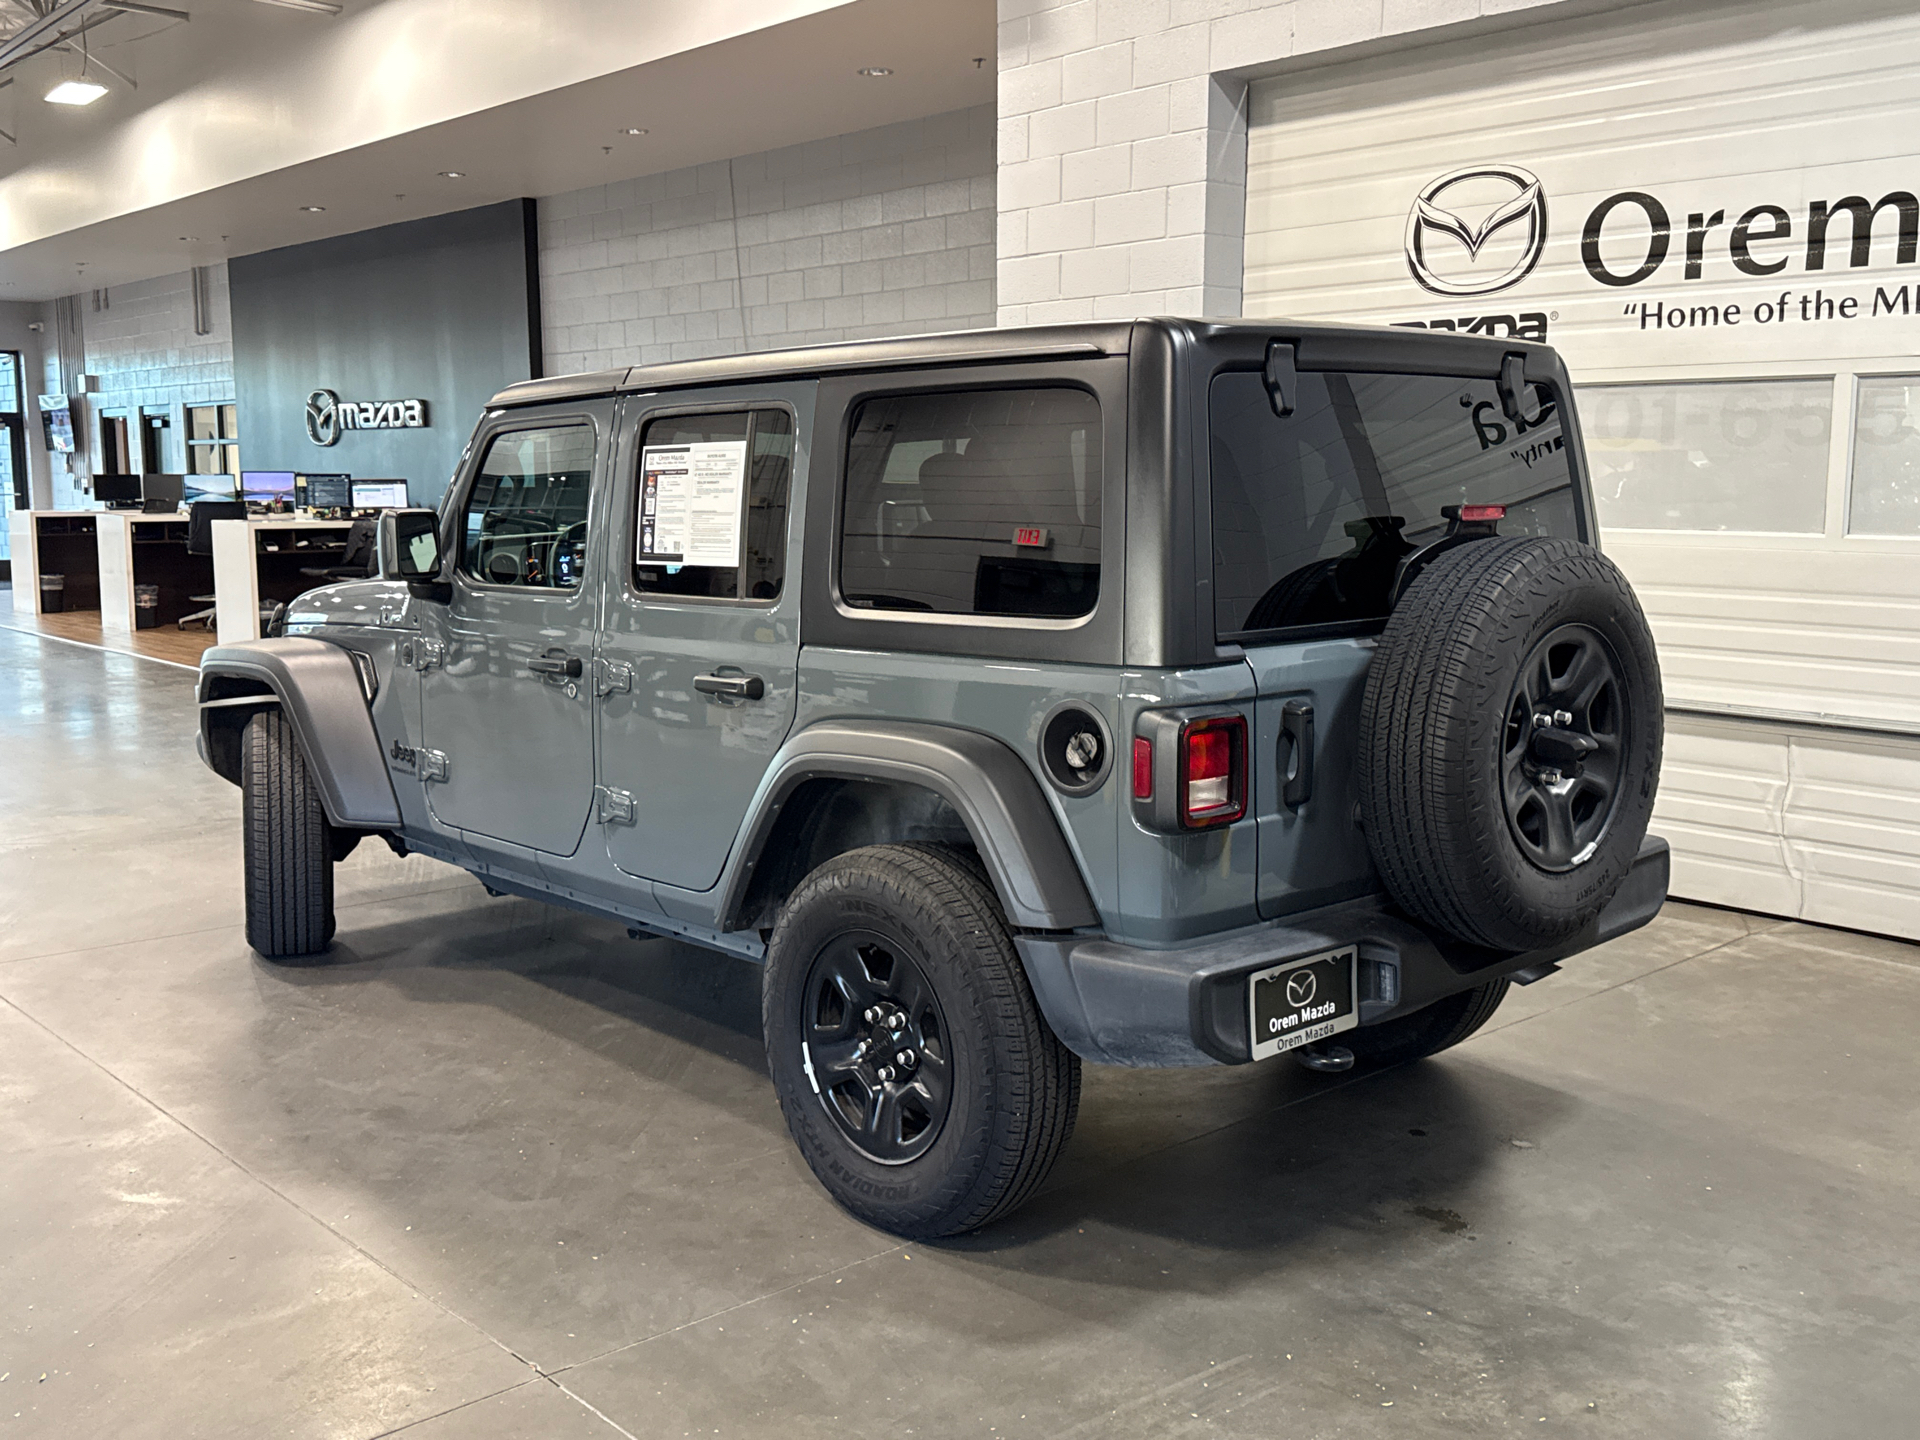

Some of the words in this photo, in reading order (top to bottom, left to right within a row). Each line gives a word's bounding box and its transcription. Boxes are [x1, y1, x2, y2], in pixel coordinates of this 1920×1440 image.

[1580, 190, 1920, 287] Orem
[1754, 291, 1791, 324] of
[1799, 290, 1858, 321] the
[390, 738, 416, 768] Jeep
[844, 899, 931, 963] NEXEN
[1269, 1013, 1298, 1033] Orem
[1301, 1000, 1336, 1023] Mazda
[1277, 1034, 1303, 1051] Orem
[1305, 1023, 1335, 1042] Mazda
[829, 1159, 910, 1200] ROADIAN
